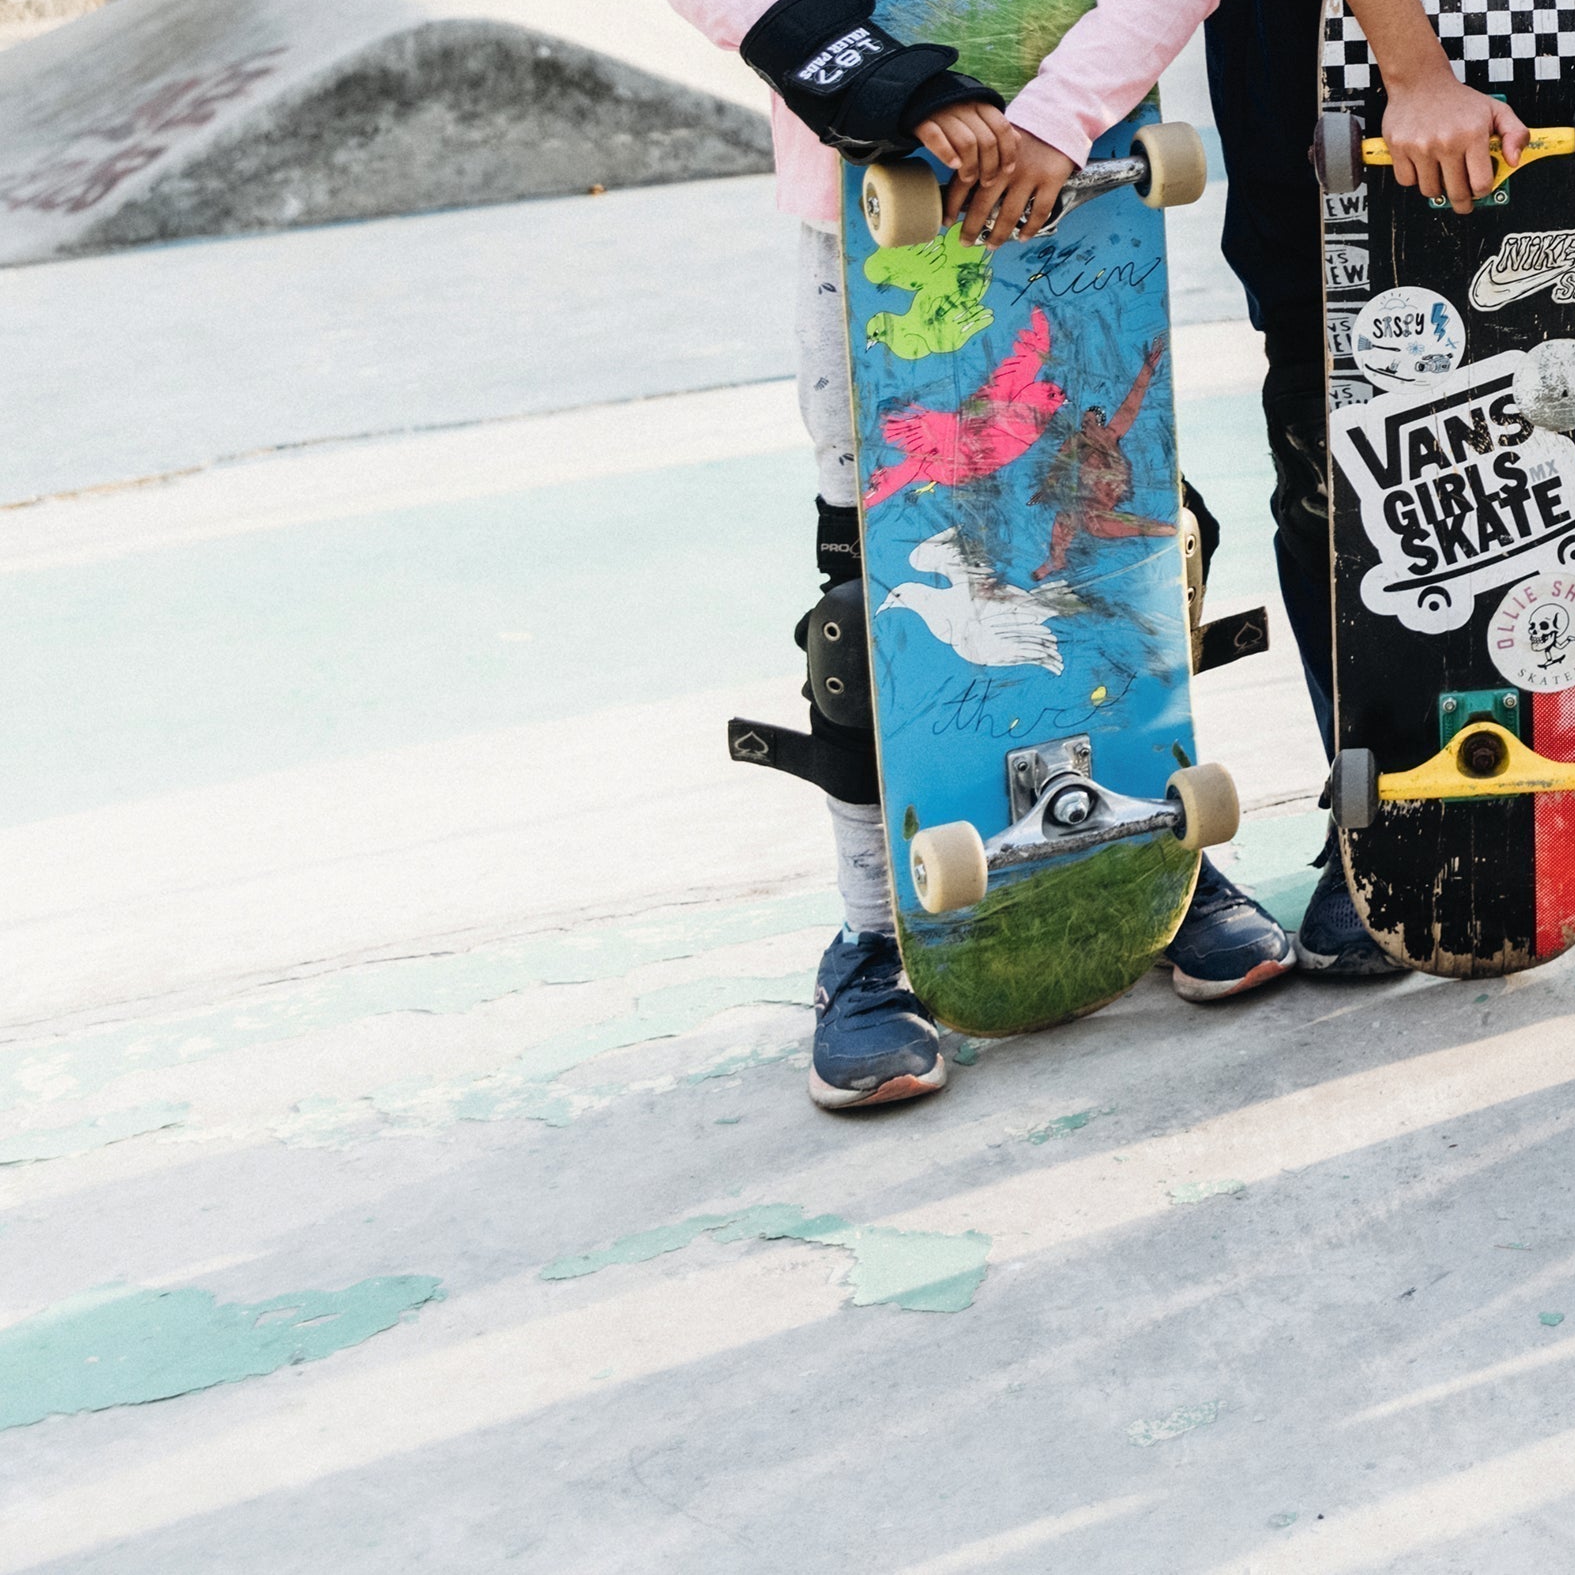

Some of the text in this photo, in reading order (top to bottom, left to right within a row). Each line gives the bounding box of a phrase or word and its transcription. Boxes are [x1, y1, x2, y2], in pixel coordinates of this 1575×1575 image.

[1346, 372, 1535, 490] VANS
[1383, 451, 1560, 535] GIRLS MX
[1400, 476, 1572, 576] SKATE
[1497, 586, 1540, 650] OLLIE
